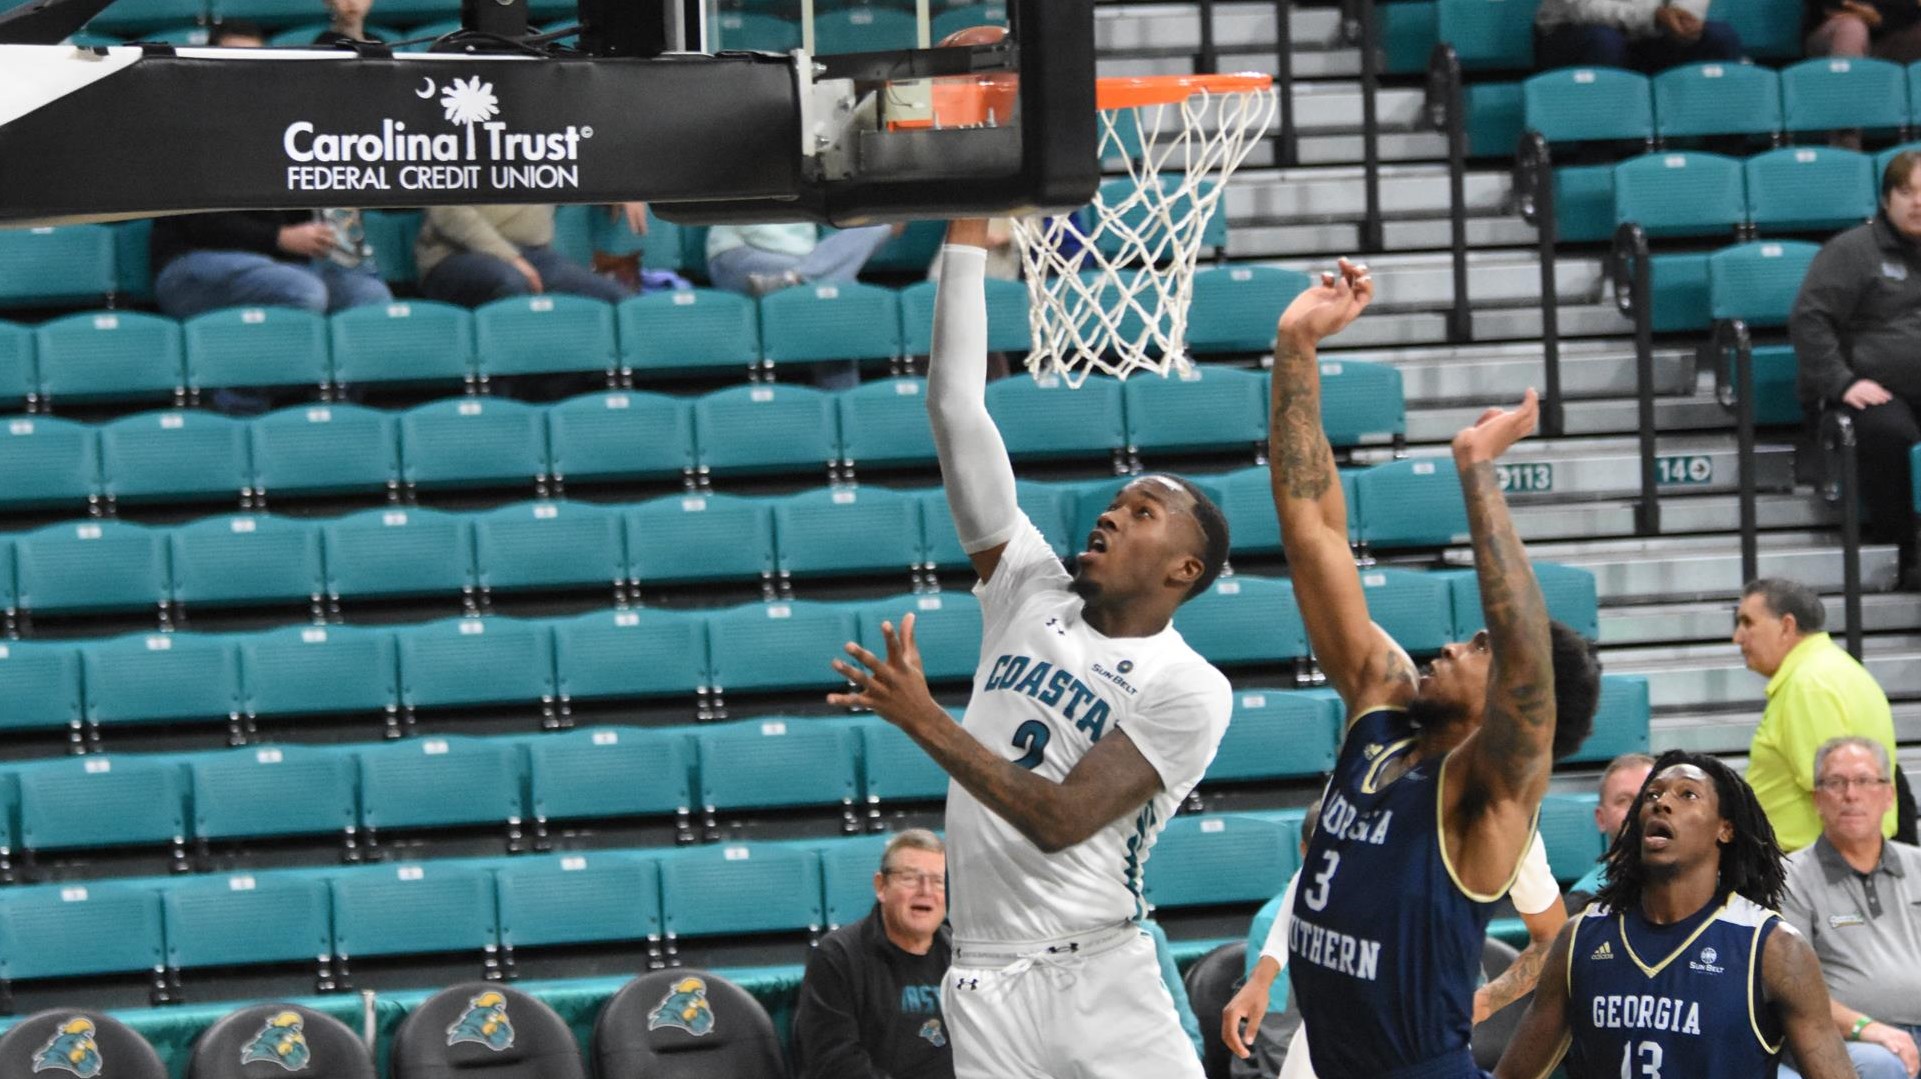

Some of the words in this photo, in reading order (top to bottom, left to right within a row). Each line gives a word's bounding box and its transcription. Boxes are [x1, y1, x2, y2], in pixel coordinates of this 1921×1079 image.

[284, 118, 458, 162] Carolina
[287, 166, 391, 190] FEDERAL
[399, 166, 481, 189] CREDIT
[491, 165, 579, 188] UNION
[1511, 466, 1550, 490] 113
[1658, 458, 1687, 482] 14
[984, 654, 1114, 743] COASTA
[1011, 719, 1050, 770] 2
[1304, 850, 1341, 912] 3
[1289, 914, 1382, 981] UTHERN
[1706, 964, 1725, 973] BELT
[1592, 995, 1701, 1036] GEORGIA
[1620, 1040, 1664, 1079] 13
